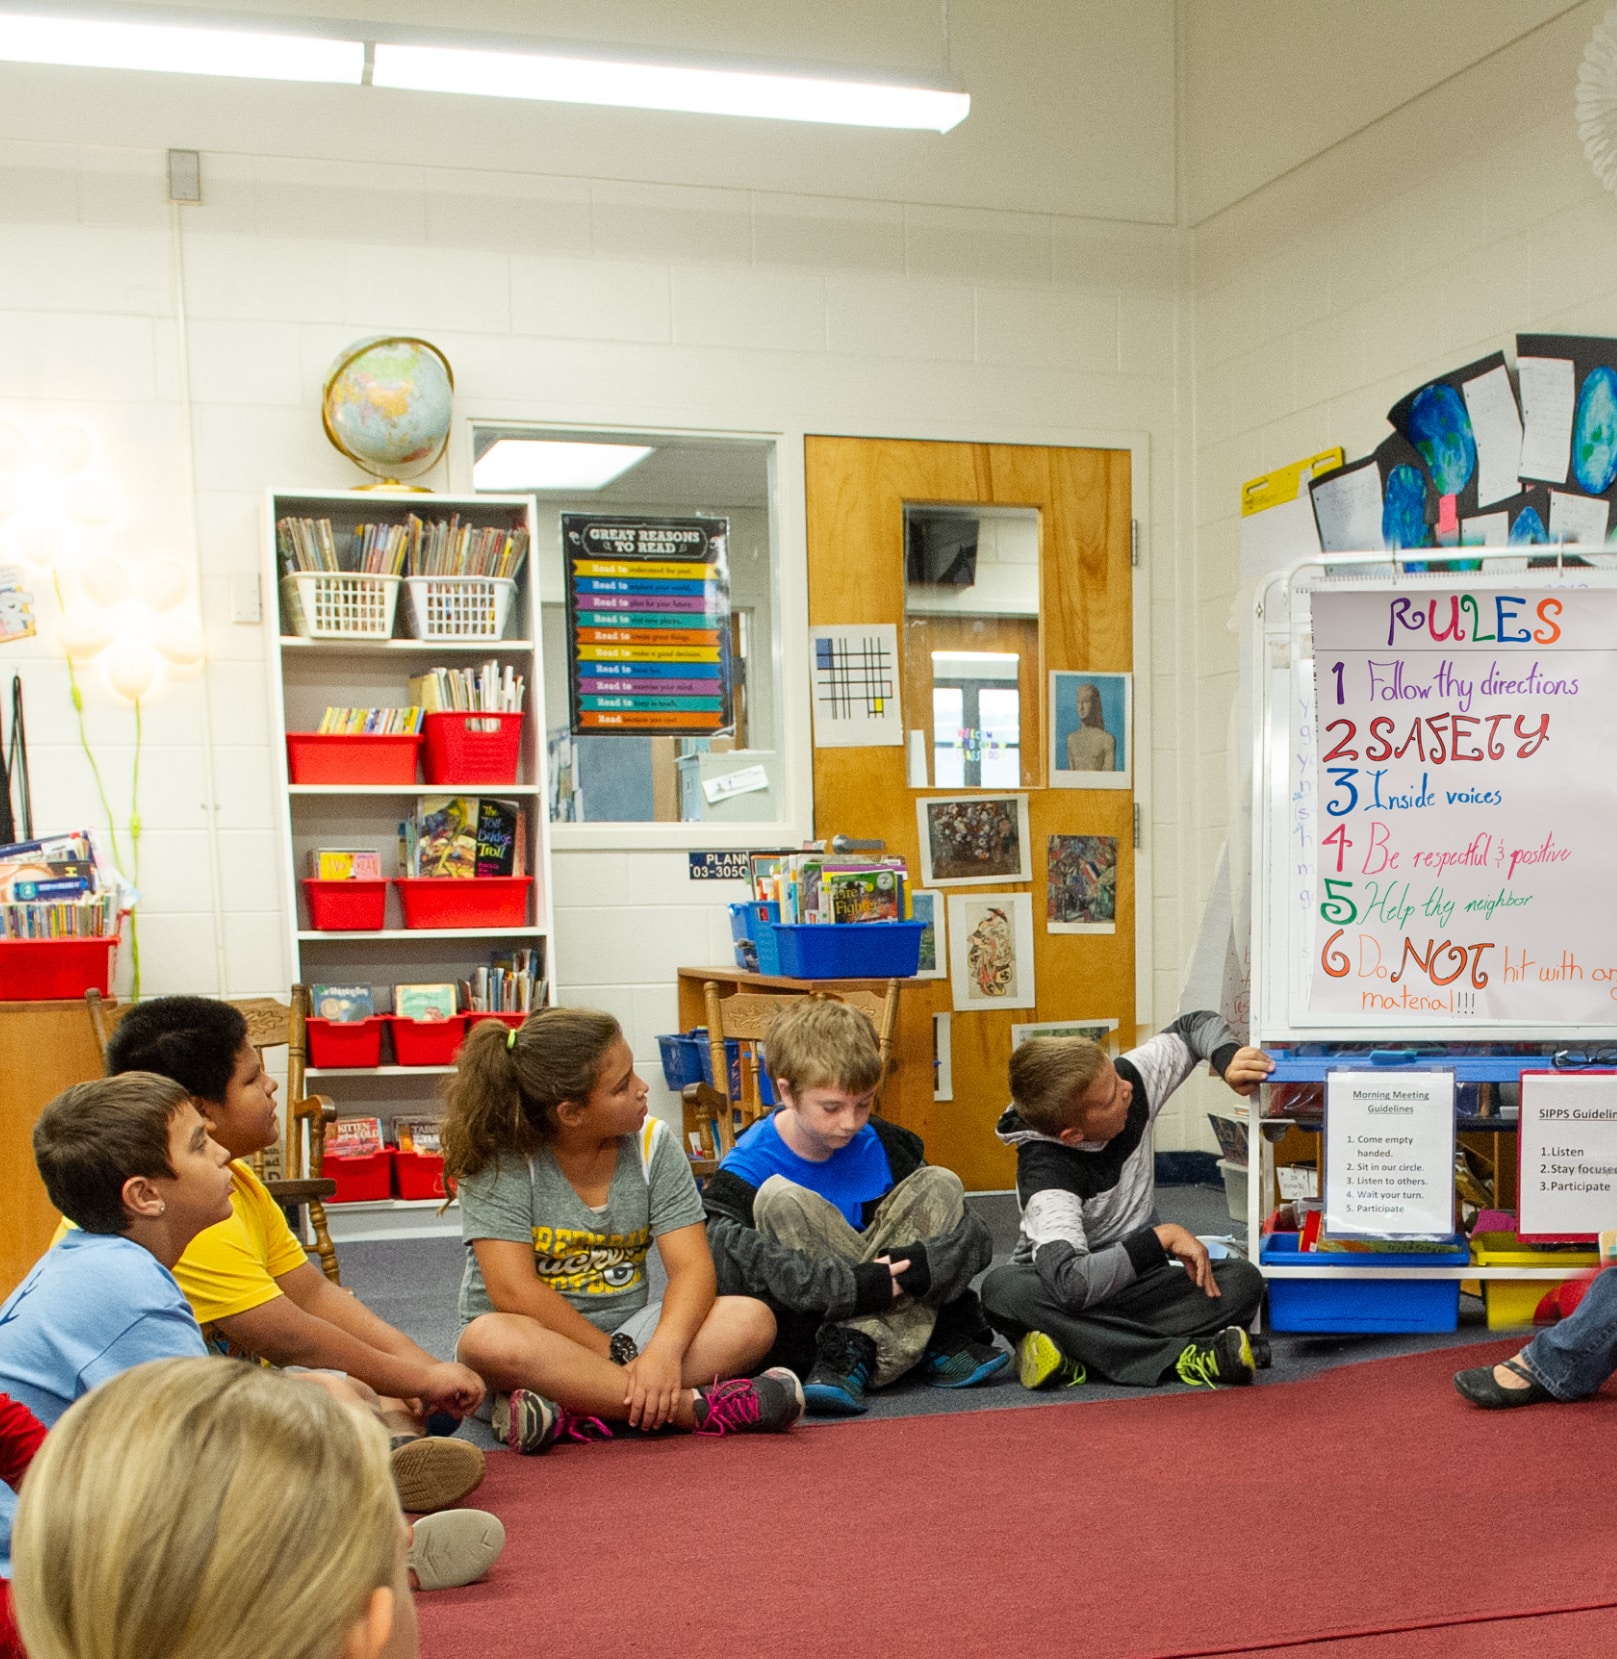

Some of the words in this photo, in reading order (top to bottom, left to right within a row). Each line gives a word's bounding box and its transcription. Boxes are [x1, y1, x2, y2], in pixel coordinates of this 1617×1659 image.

[589, 528, 637, 542] GREAT
[639, 529, 700, 543] REASONS
[614, 541, 635, 552] TO
[638, 542, 676, 553] READ
[1387, 594, 1563, 646] RULES
[1331, 660, 1346, 705] 1
[1368, 659, 1433, 702] Follow
[1434, 660, 1474, 713] thy
[1480, 661, 1580, 697] directions
[1322, 717, 1359, 763] 2
[1365, 712, 1551, 765] SAFETY
[1326, 768, 1358, 816] 3
[1363, 769, 1436, 812] Inside
[1446, 788, 1503, 807] voices
[1321, 823, 1353, 872] 4
[1361, 822, 1400, 875] Be
[1413, 832, 1493, 877] respectful
[1508, 830, 1573, 881] positive
[1320, 877, 1358, 926] 5
[1356, 880, 1416, 930] Help
[1464, 887, 1534, 922] neighbor
[1321, 928, 1351, 978] 6
[1357, 934, 1388, 979] Do
[1390, 936, 1495, 990] NOT
[1503, 946, 1535, 984] hit
[1540, 950, 1583, 984] with
[1353, 1091, 1391, 1100] Morning
[1393, 1091, 1430, 1100] Meeting
[1367, 1105, 1414, 1114] Guidelines
[1539, 1108, 1570, 1119] SIPPS
[1357, 1136, 1383, 1144] Come
[1385, 1136, 1413, 1146] empty
[1357, 1149, 1393, 1158] handed.
[1357, 1163, 1369, 1171] Sit
[1371, 1163, 1379, 1171] in
[1399, 1163, 1425, 1172] circle.
[1357, 1177, 1383, 1185] Listen
[1397, 1177, 1428, 1186] others.
[1357, 1191, 1378, 1199] Wait
[1380, 1192, 1400, 1201] your
[1357, 1204, 1404, 1214] Participate
